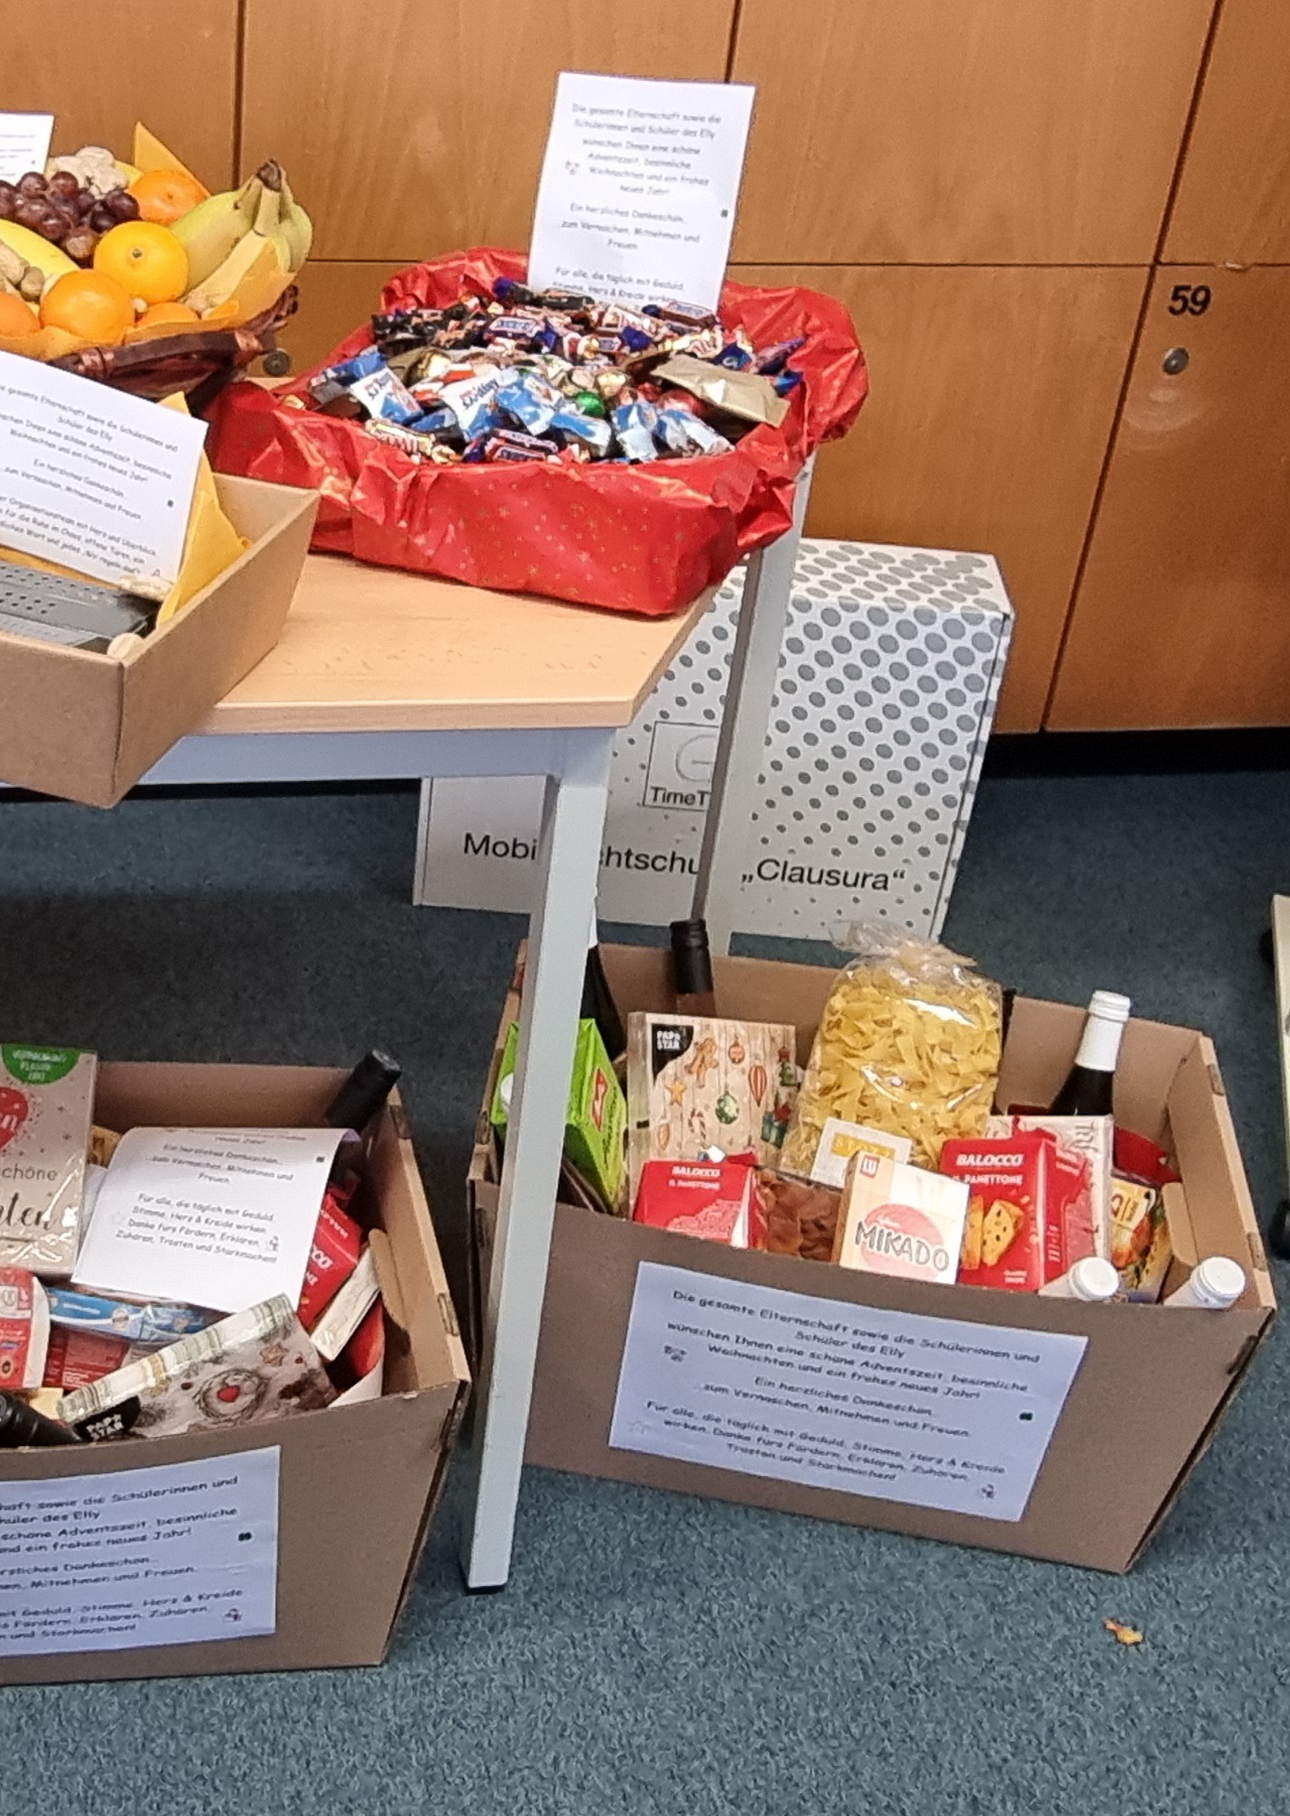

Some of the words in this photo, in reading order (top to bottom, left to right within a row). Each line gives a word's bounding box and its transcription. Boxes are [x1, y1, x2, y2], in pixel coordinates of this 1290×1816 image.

[1168, 284, 1211, 316] 59
[650, 786, 710, 807] TimeT
[463, 832, 537, 861] Mobi
[741, 858, 906, 891] „Clausura“
[956, 1154, 1024, 1167] BALOCCO
[855, 1221, 950, 1272] MIKADO
